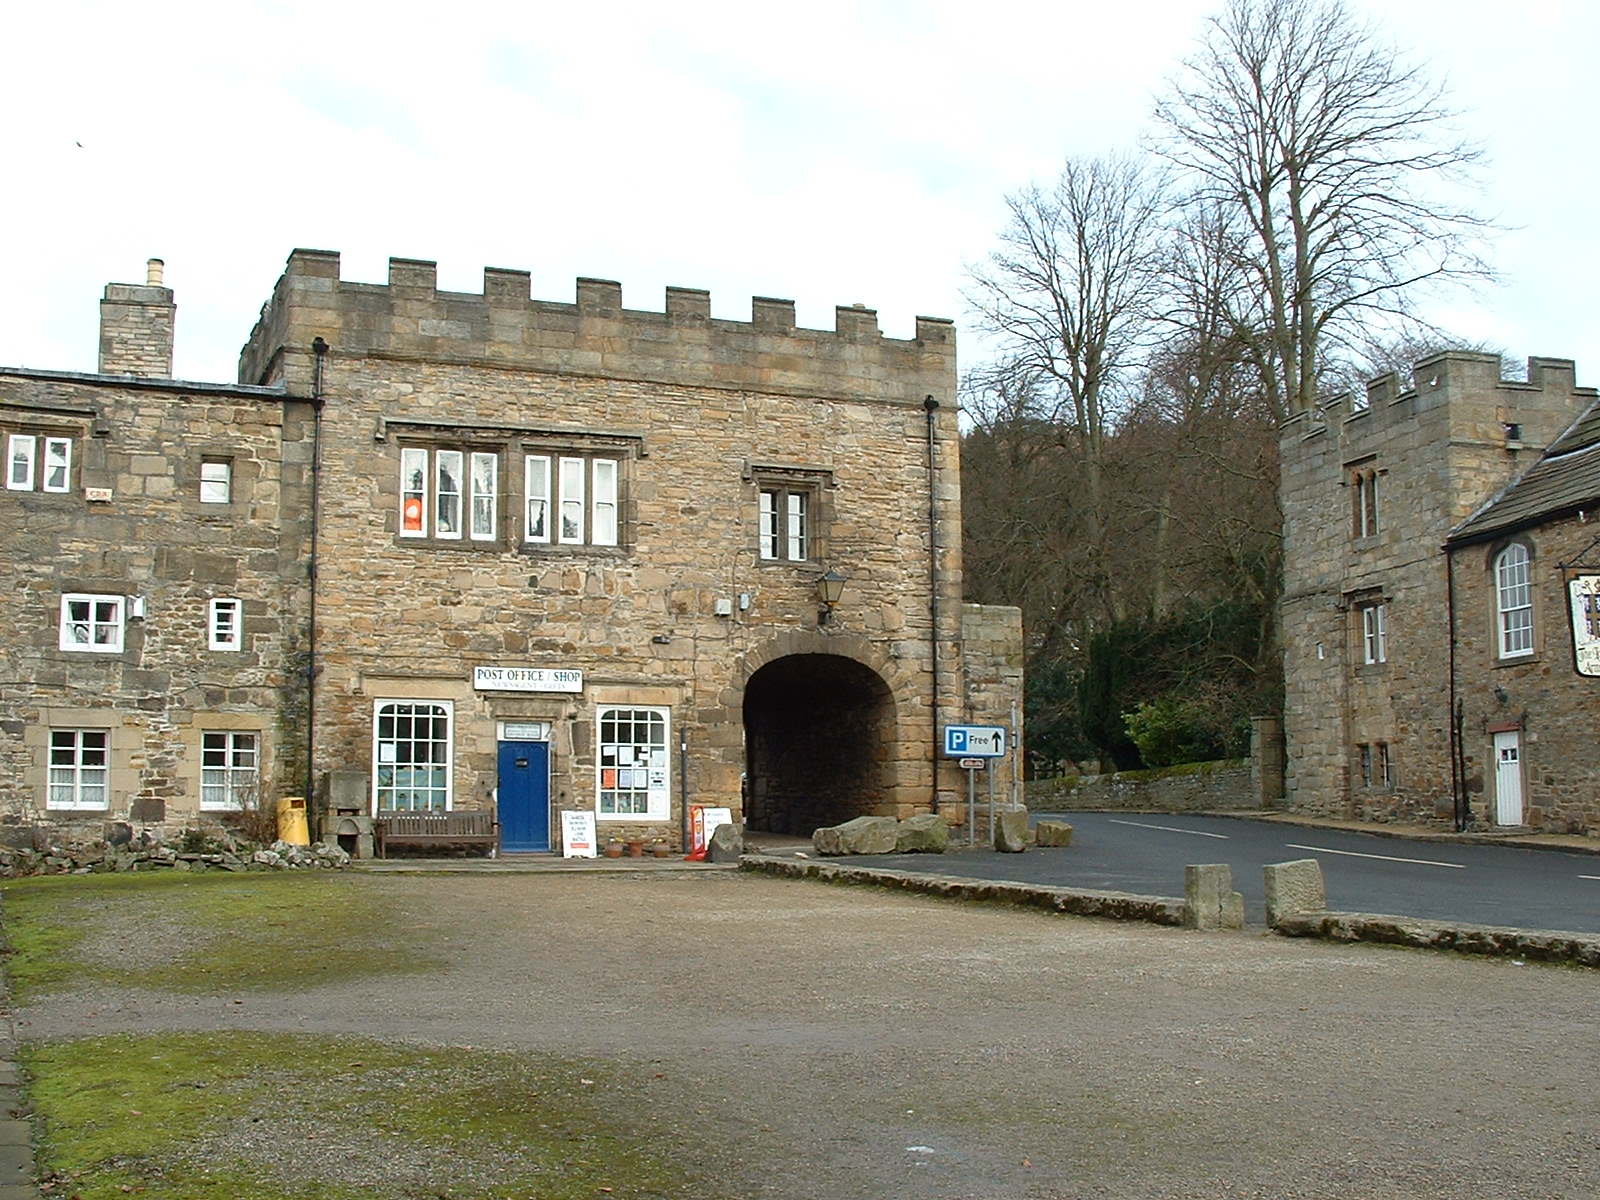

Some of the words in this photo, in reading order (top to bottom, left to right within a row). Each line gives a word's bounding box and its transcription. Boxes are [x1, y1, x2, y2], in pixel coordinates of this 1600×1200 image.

[477, 668, 503, 680] POST
[507, 670, 545, 681] OFFICE
[553, 671, 580, 682] SHOP
[952, 732, 964, 749] P
[969, 735, 989, 745] Free
